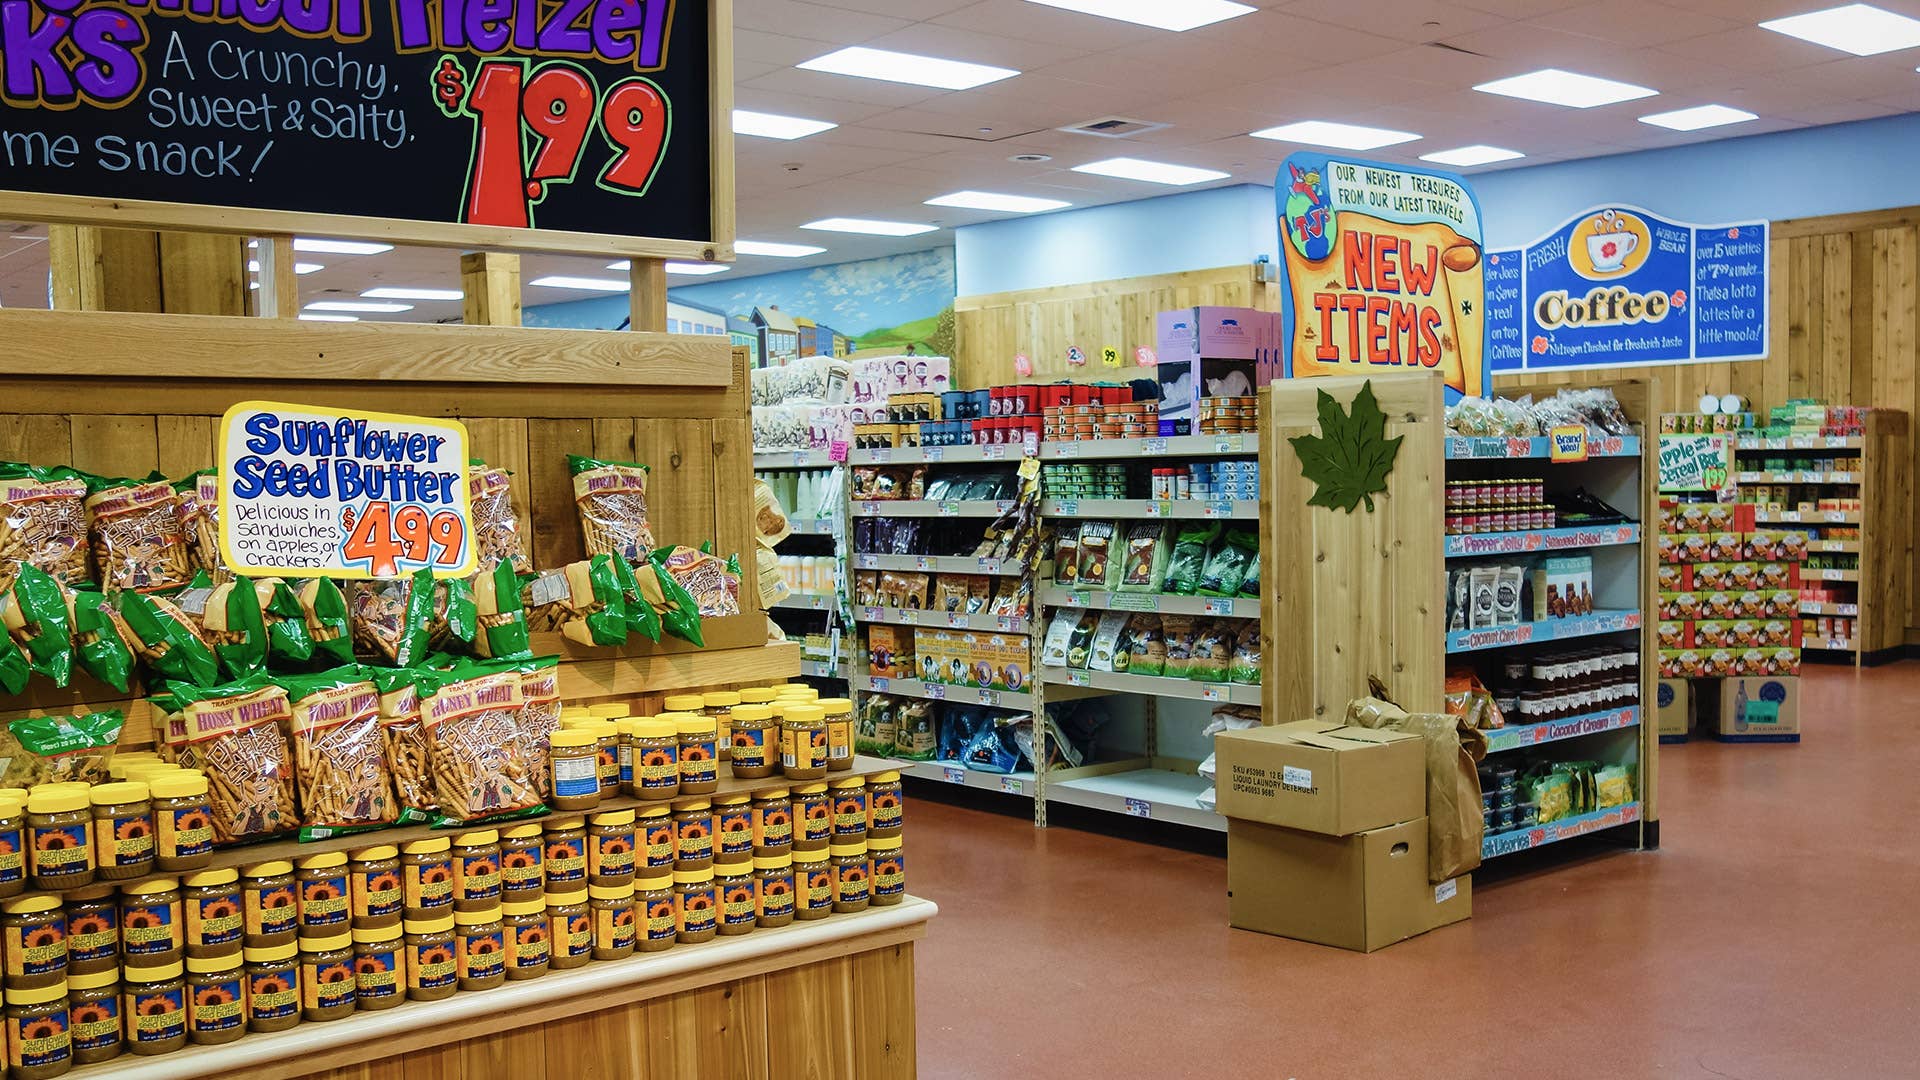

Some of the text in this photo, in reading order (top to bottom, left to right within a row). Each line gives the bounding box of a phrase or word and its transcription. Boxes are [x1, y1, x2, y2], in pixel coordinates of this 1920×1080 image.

[162, 30, 400, 101] A Crunchy,
[148, 87, 416, 149] Sweet & Salty,
[435, 57, 668, 229] $1.99
[2, 129, 275, 183] me snack!
[1335, 165, 1461, 203] OUR NEWEST TREASURES
[1338, 188, 1464, 225] FROM OUR LATEST TRAVELS
[1656, 227, 1688, 243] WHOLE
[1528, 236, 1566, 272] FRESH
[1658, 239, 1686, 253] BEAN
[1714, 243, 1724, 258] 15
[1724, 242, 1762, 257] varieties
[1343, 229, 1438, 297] NEW
[1697, 266, 1707, 281] at
[1731, 283, 1757, 299] lotta
[1494, 304, 1513, 320] real
[1537, 290, 1666, 328] Coffee
[1699, 305, 1755, 322] lattes for a
[1313, 292, 1441, 368] ITEMS
[1491, 326, 1519, 341] on top
[1699, 323, 1763, 344] little moola!
[1492, 344, 1522, 360] Coffees
[1613, 339, 1623, 351] for
[1661, 336, 1683, 348] taste
[245, 412, 446, 464] Sunflower
[1473, 438, 1508, 458] Almonds
[1555, 433, 1582, 446] Brand
[1560, 443, 1580, 454] New!
[1659, 456, 1699, 485] Cereal
[1697, 450, 1720, 471] Bar
[232, 454, 461, 505] Seed Butter
[235, 503, 331, 521] Delicious in
[237, 539, 261, 550] on
[342, 500, 463, 577] $4.99
[1463, 535, 1500, 553] Pepper
[1501, 535, 1523, 551] Jelly
[1546, 533, 1578, 549] Seaweed
[1578, 531, 1601, 546] Salad
[326, 690, 349, 699] TRADER
[432, 684, 514, 718] HONEY WHEAT
[196, 696, 284, 733] HONEY WHEAT
[309, 700, 347, 722] HONEY
[1550, 720, 1583, 739] Coconut
[1583, 718, 1609, 733] Cream
[1232, 764, 1246, 774] SKU
[1269, 771, 1276, 780] 12
[1233, 774, 1252, 785] LIQUID
[1253, 777, 1281, 789] LAUNDRY
